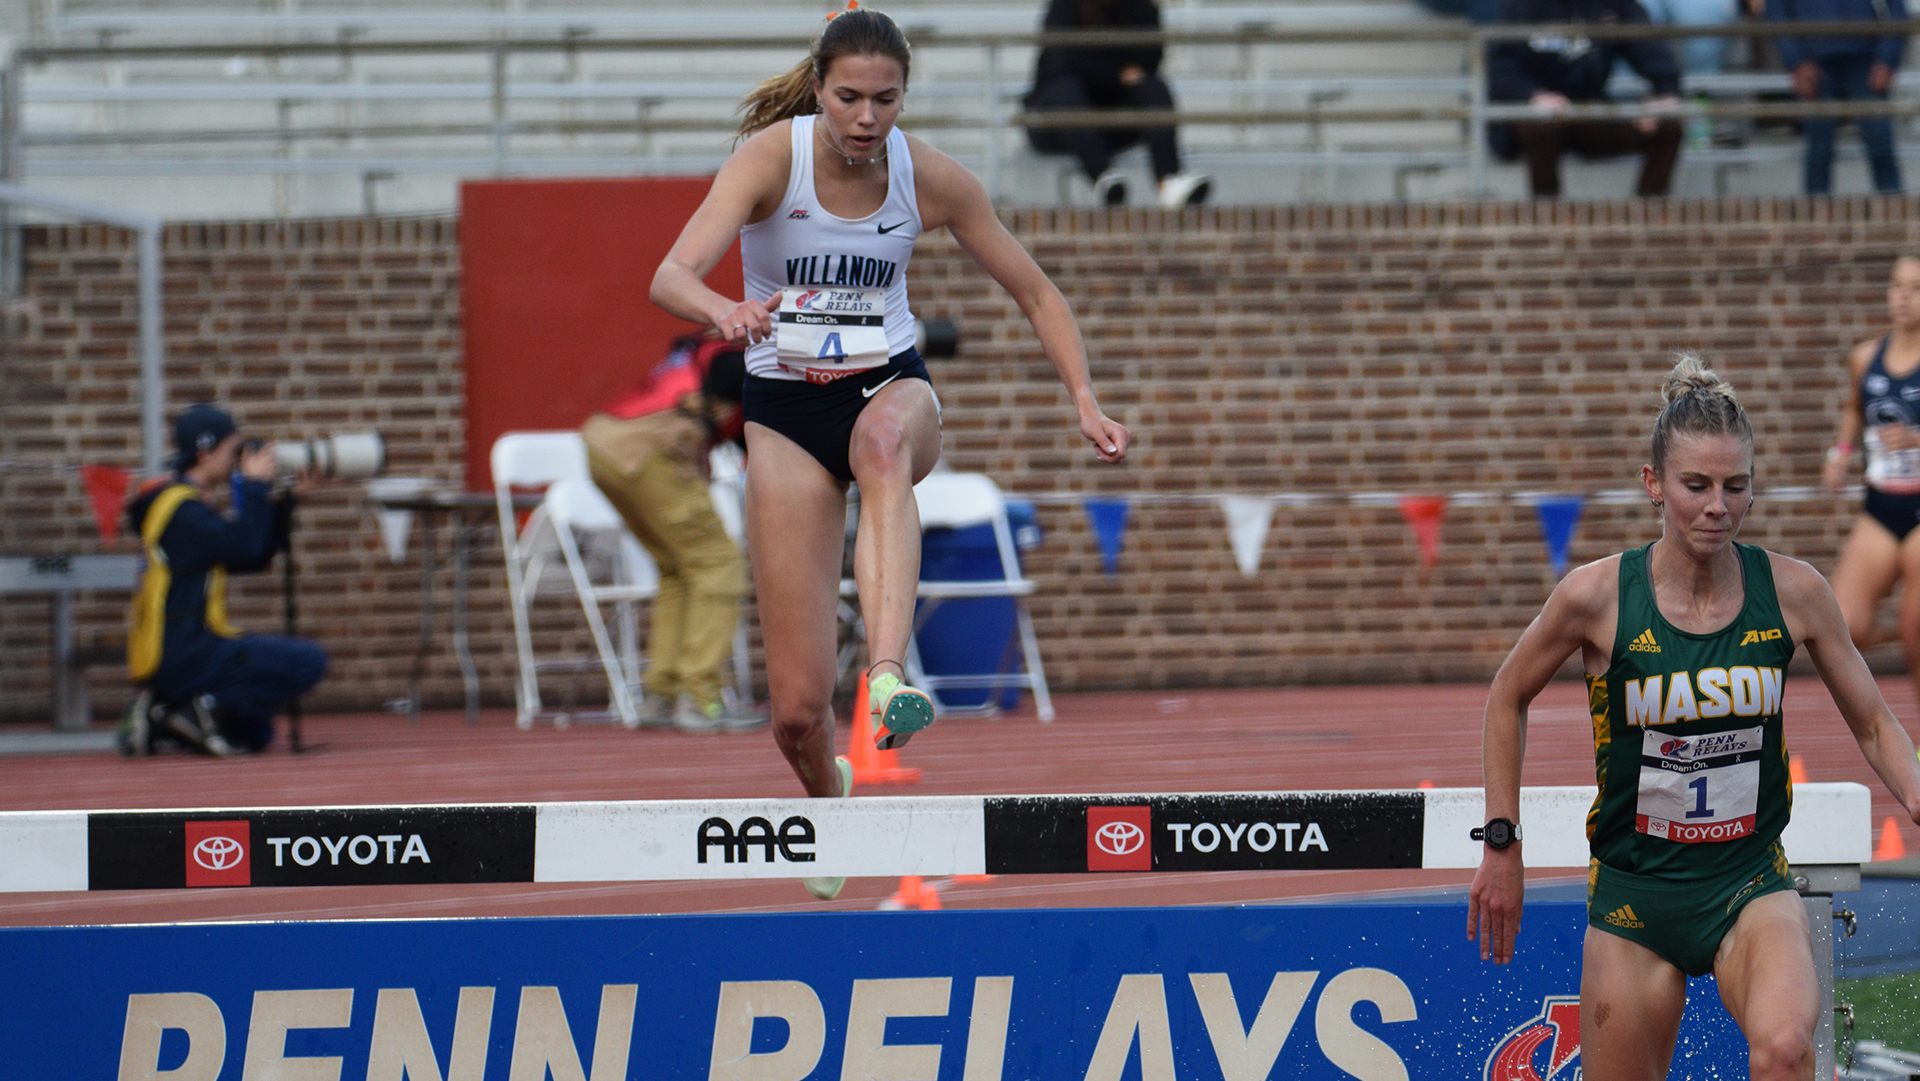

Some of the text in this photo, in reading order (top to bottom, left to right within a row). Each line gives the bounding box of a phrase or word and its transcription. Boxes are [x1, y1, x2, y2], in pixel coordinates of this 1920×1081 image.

[786, 254, 897, 288] VILLANOVA
[829, 291, 864, 301] PENN
[825, 301, 873, 312] RELAYS
[796, 314, 839, 325] Dream On.
[817, 332, 848, 364] 4
[809, 370, 862, 383] TOY
[1628, 642, 1662, 654] adidas
[1625, 666, 1782, 726] MASON
[1696, 734, 1738, 748] PENN
[1692, 741, 1748, 758] RELAYS
[1661, 760, 1709, 772] Dream On.
[1685, 776, 1714, 819] 1
[1167, 822, 1329, 853] TOYOTA
[1673, 821, 1744, 840] TOYOTA
[266, 833, 431, 867] TOYOTA
[1603, 914, 1645, 929] adidas
